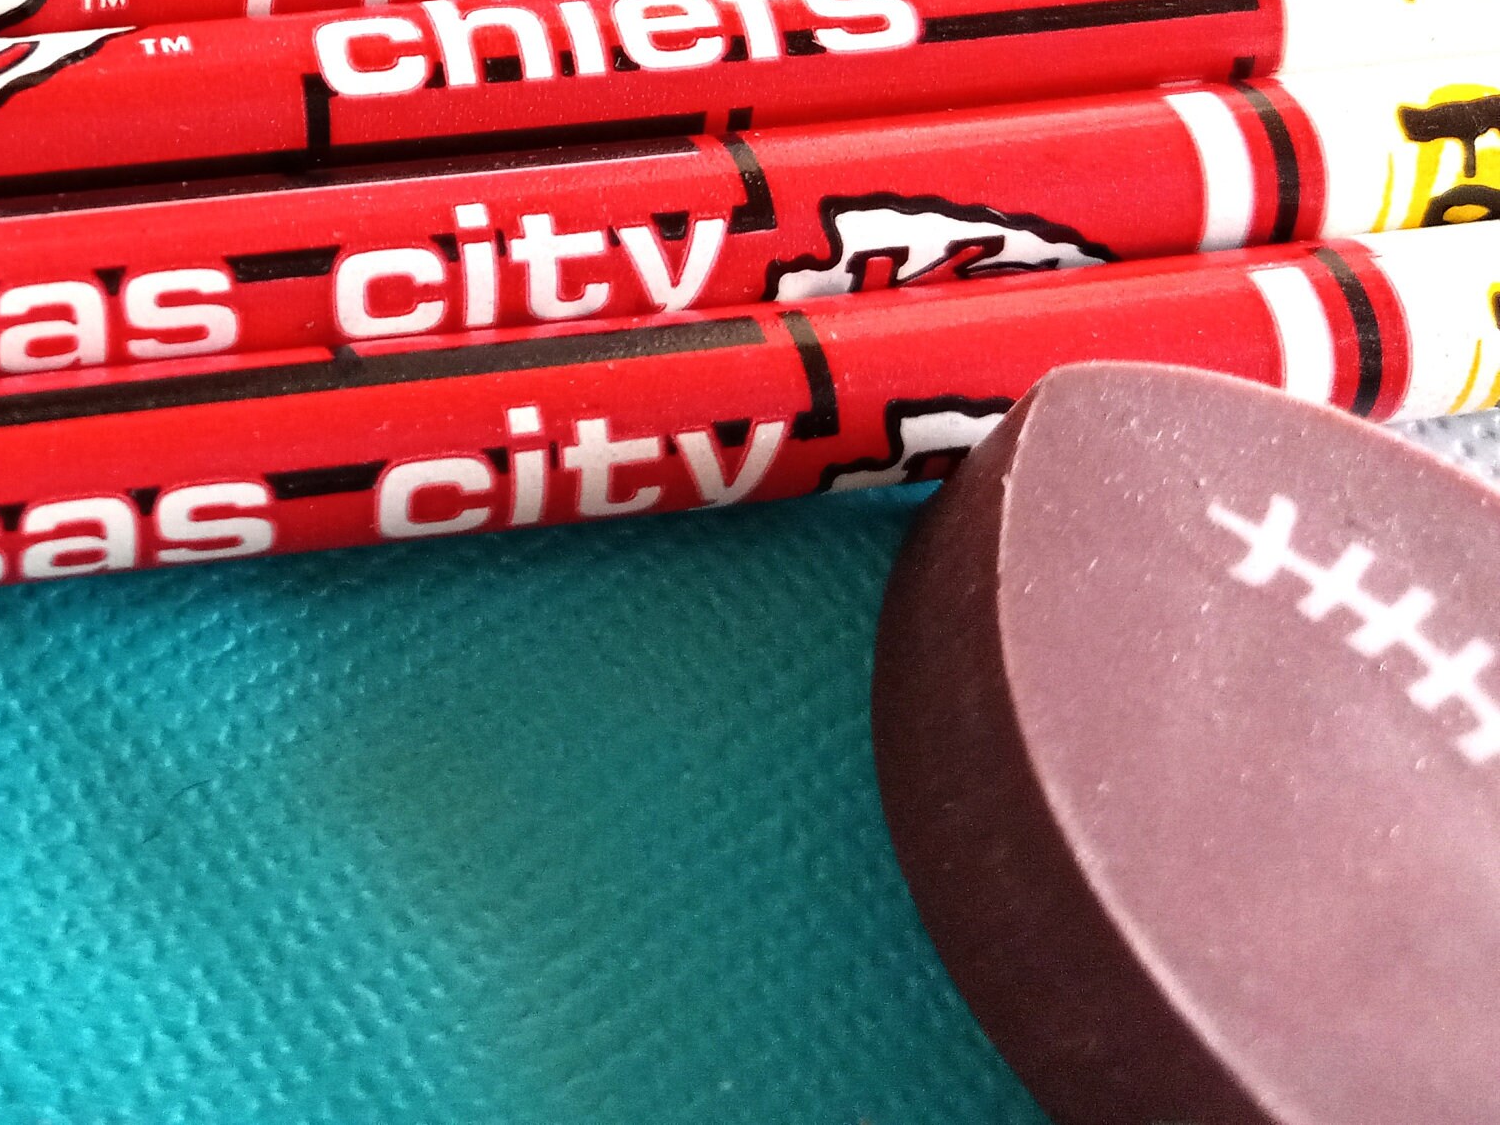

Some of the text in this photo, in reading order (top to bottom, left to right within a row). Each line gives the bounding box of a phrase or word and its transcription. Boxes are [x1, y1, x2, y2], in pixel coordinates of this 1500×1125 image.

[140, 35, 192, 57] TM
[333, 202, 728, 338] city
[377, 405, 793, 541] city
